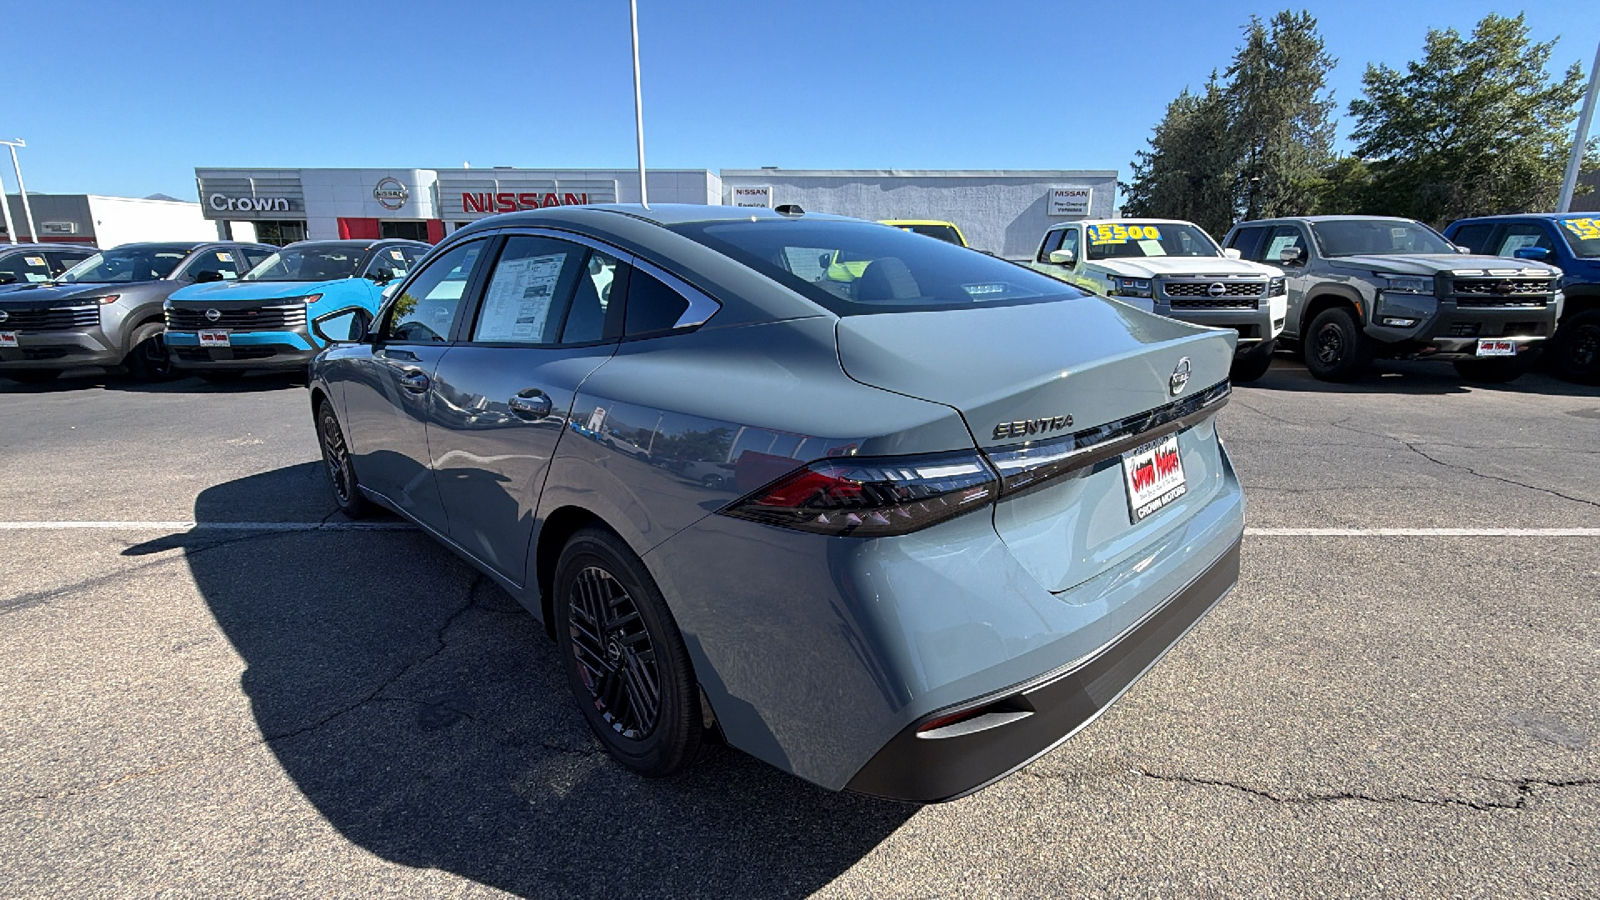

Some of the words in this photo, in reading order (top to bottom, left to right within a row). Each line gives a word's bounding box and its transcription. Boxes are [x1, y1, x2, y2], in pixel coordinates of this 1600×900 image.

[210, 193, 289, 211] Crown
[462, 192, 588, 213] NISSAN
[1088, 226, 1159, 240] $5500
[992, 413, 1074, 440] SENTRA
[1138, 498, 1162, 518] CROWN
[1161, 484, 1186, 505] MOTORS
